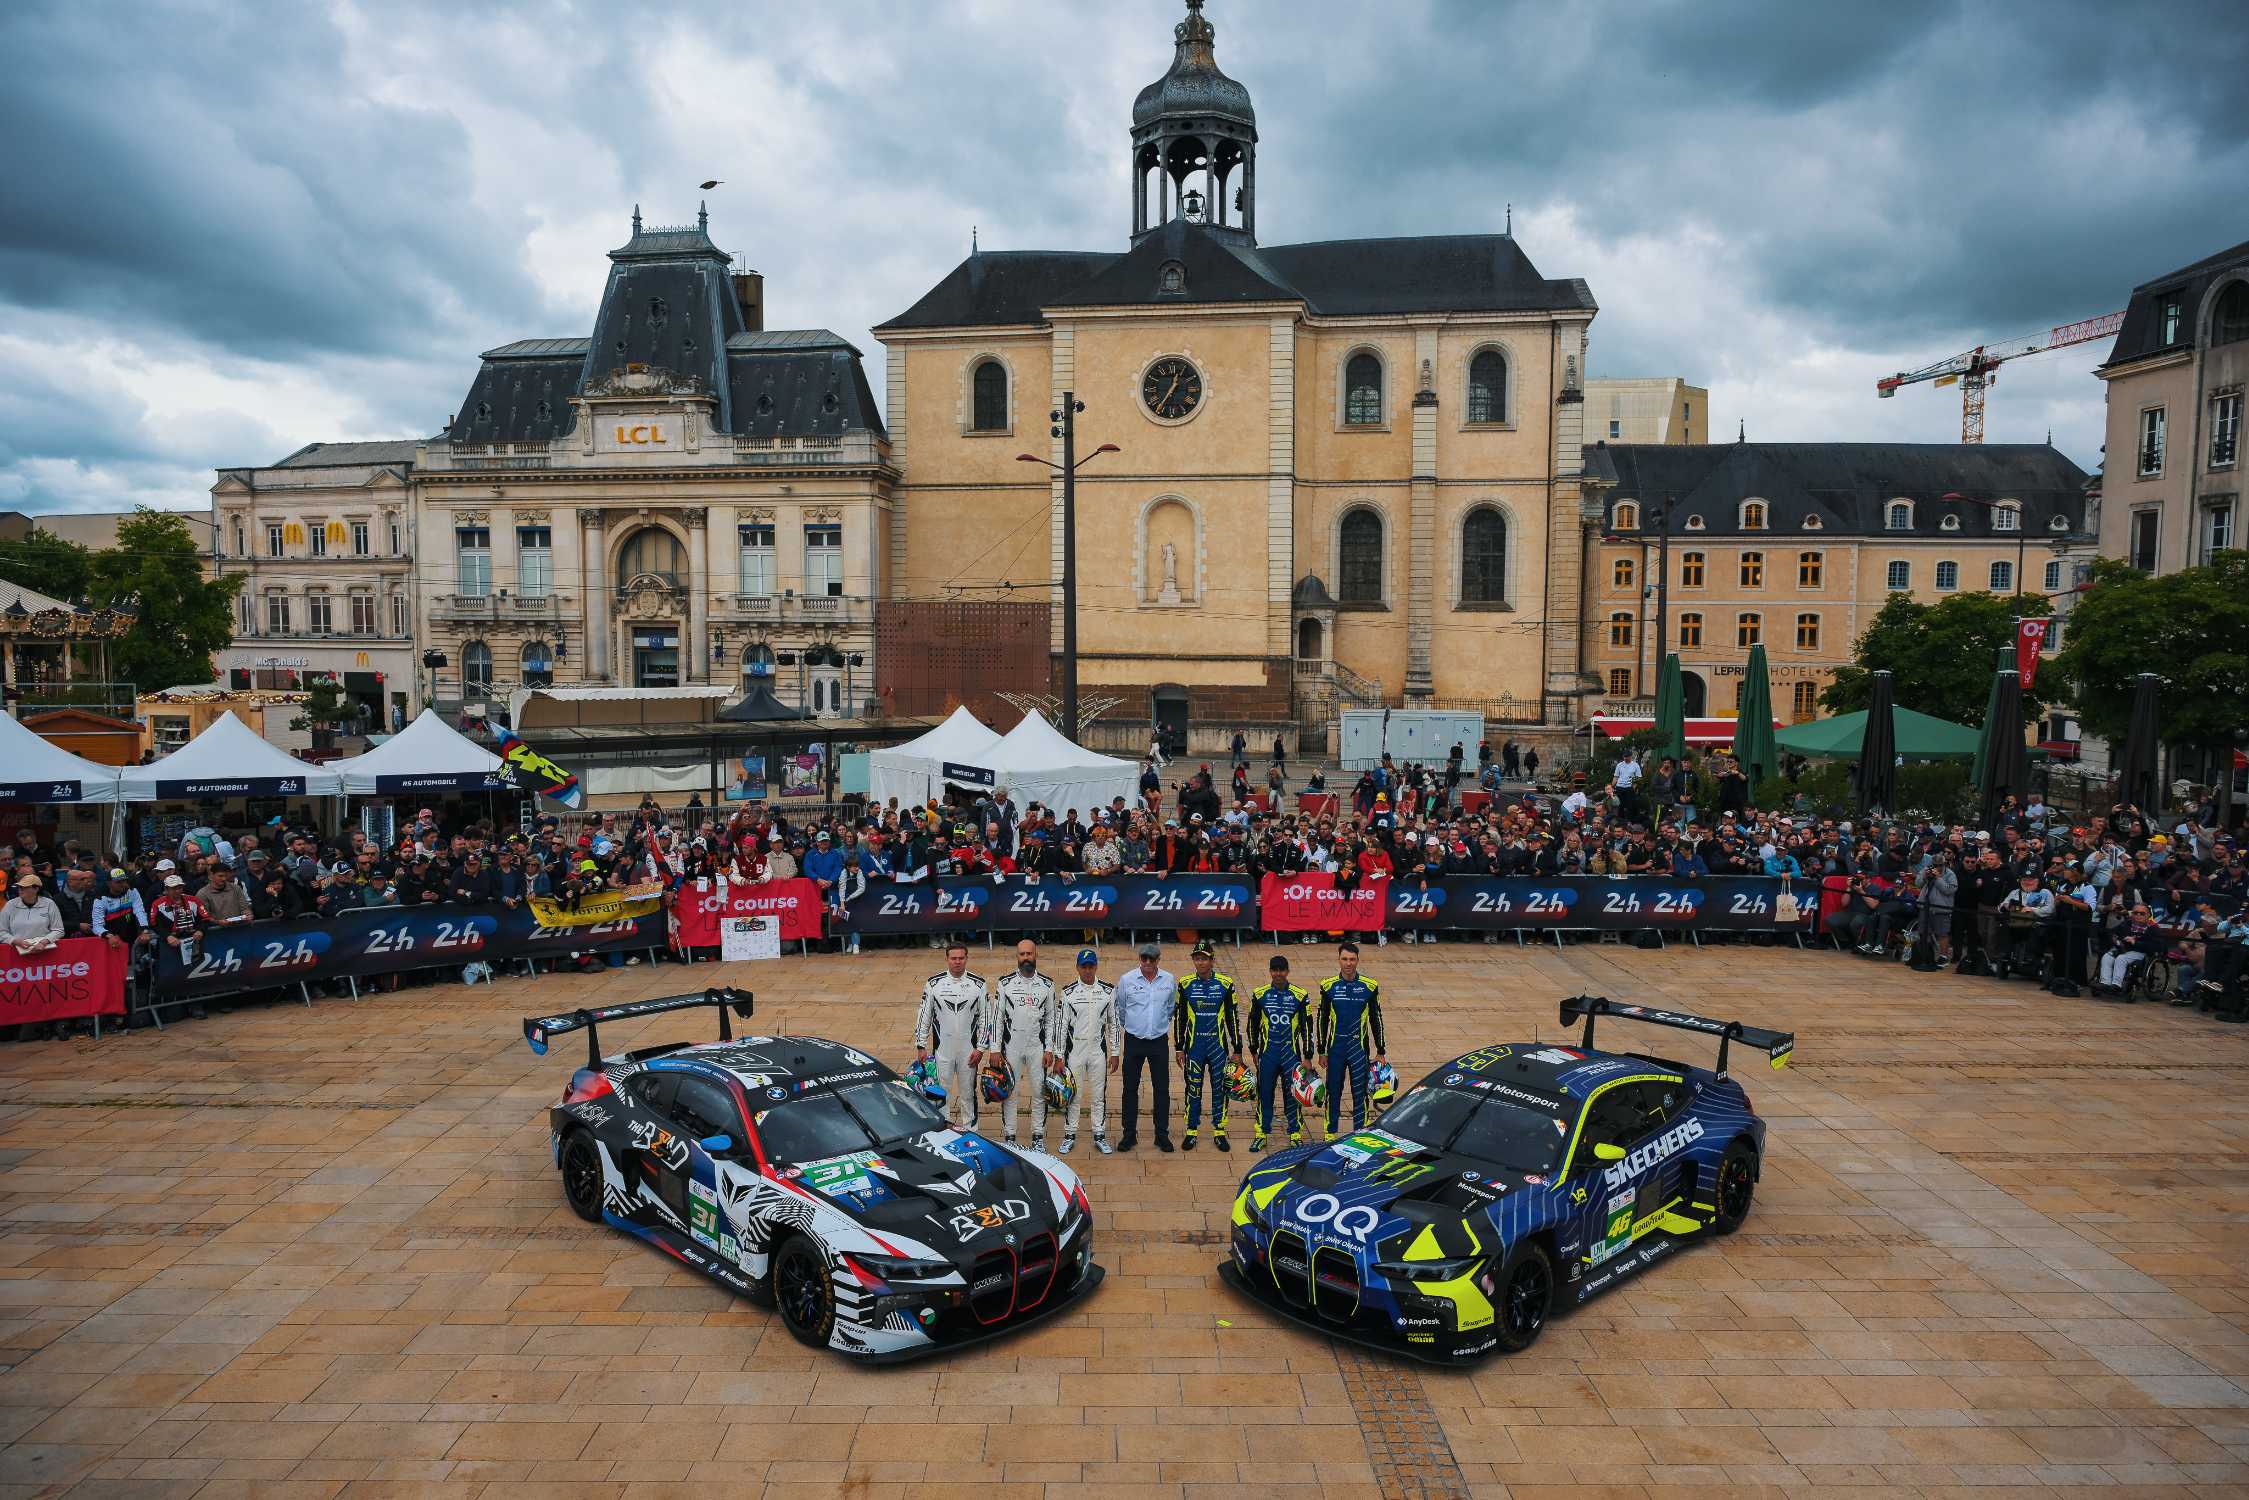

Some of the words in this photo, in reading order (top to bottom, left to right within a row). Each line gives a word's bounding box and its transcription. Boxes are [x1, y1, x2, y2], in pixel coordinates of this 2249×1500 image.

[617, 425, 667, 445] LCL
[1714, 666, 1745, 676] LEPRI
[1771, 666, 1815, 677] HOTEL
[186, 785, 197, 793] RS
[198, 784, 249, 792] AUTOMOBILE
[413, 778, 457, 786] AUTOMOBILE
[734, 896, 798, 911] course
[879, 894, 919, 914] 24h
[1010, 890, 1050, 912] 24h
[1065, 890, 1104, 912] 24h
[1143, 889, 1183, 911] 24h
[1197, 889, 1238, 911] 24h
[1395, 892, 1434, 913] 24h
[1472, 892, 1511, 912] 24h
[1525, 892, 1564, 913] 24h
[1602, 892, 1641, 913] 24h
[1653, 892, 1693, 913] 24h
[1729, 894, 1767, 914] 24h
[1288, 903, 1310, 921] LE
[1320, 901, 1376, 921] MANS
[363, 926, 415, 954] 24h
[432, 921, 480, 948] 24h
[187, 949, 242, 979] 24h
[260, 939, 314, 968] 24h
[1270, 1013, 1290, 1025] OQ
[818, 1069, 880, 1085] Motorsport
[1493, 1084, 1560, 1110] Motorsport
[1604, 1116, 1706, 1192] SKECHERS
[814, 1162, 855, 1185] 31
[1457, 1182, 1496, 1201] Motorsport
[690, 1203, 717, 1234] 31
[953, 1202, 977, 1215] THE
[1296, 1193, 1379, 1243] OQ
[1279, 1218, 1294, 1229] BMW
[1293, 1223, 1312, 1235] OMAN
[1607, 1210, 1633, 1238] 46
[1634, 1211, 1665, 1234] GOODYEAR
[1324, 1235, 1342, 1246] BMW
[1341, 1239, 1364, 1254] OMAN
[1408, 1317, 1441, 1327] AnyDesk
[1453, 1338, 1497, 1356] GOODYEAR
